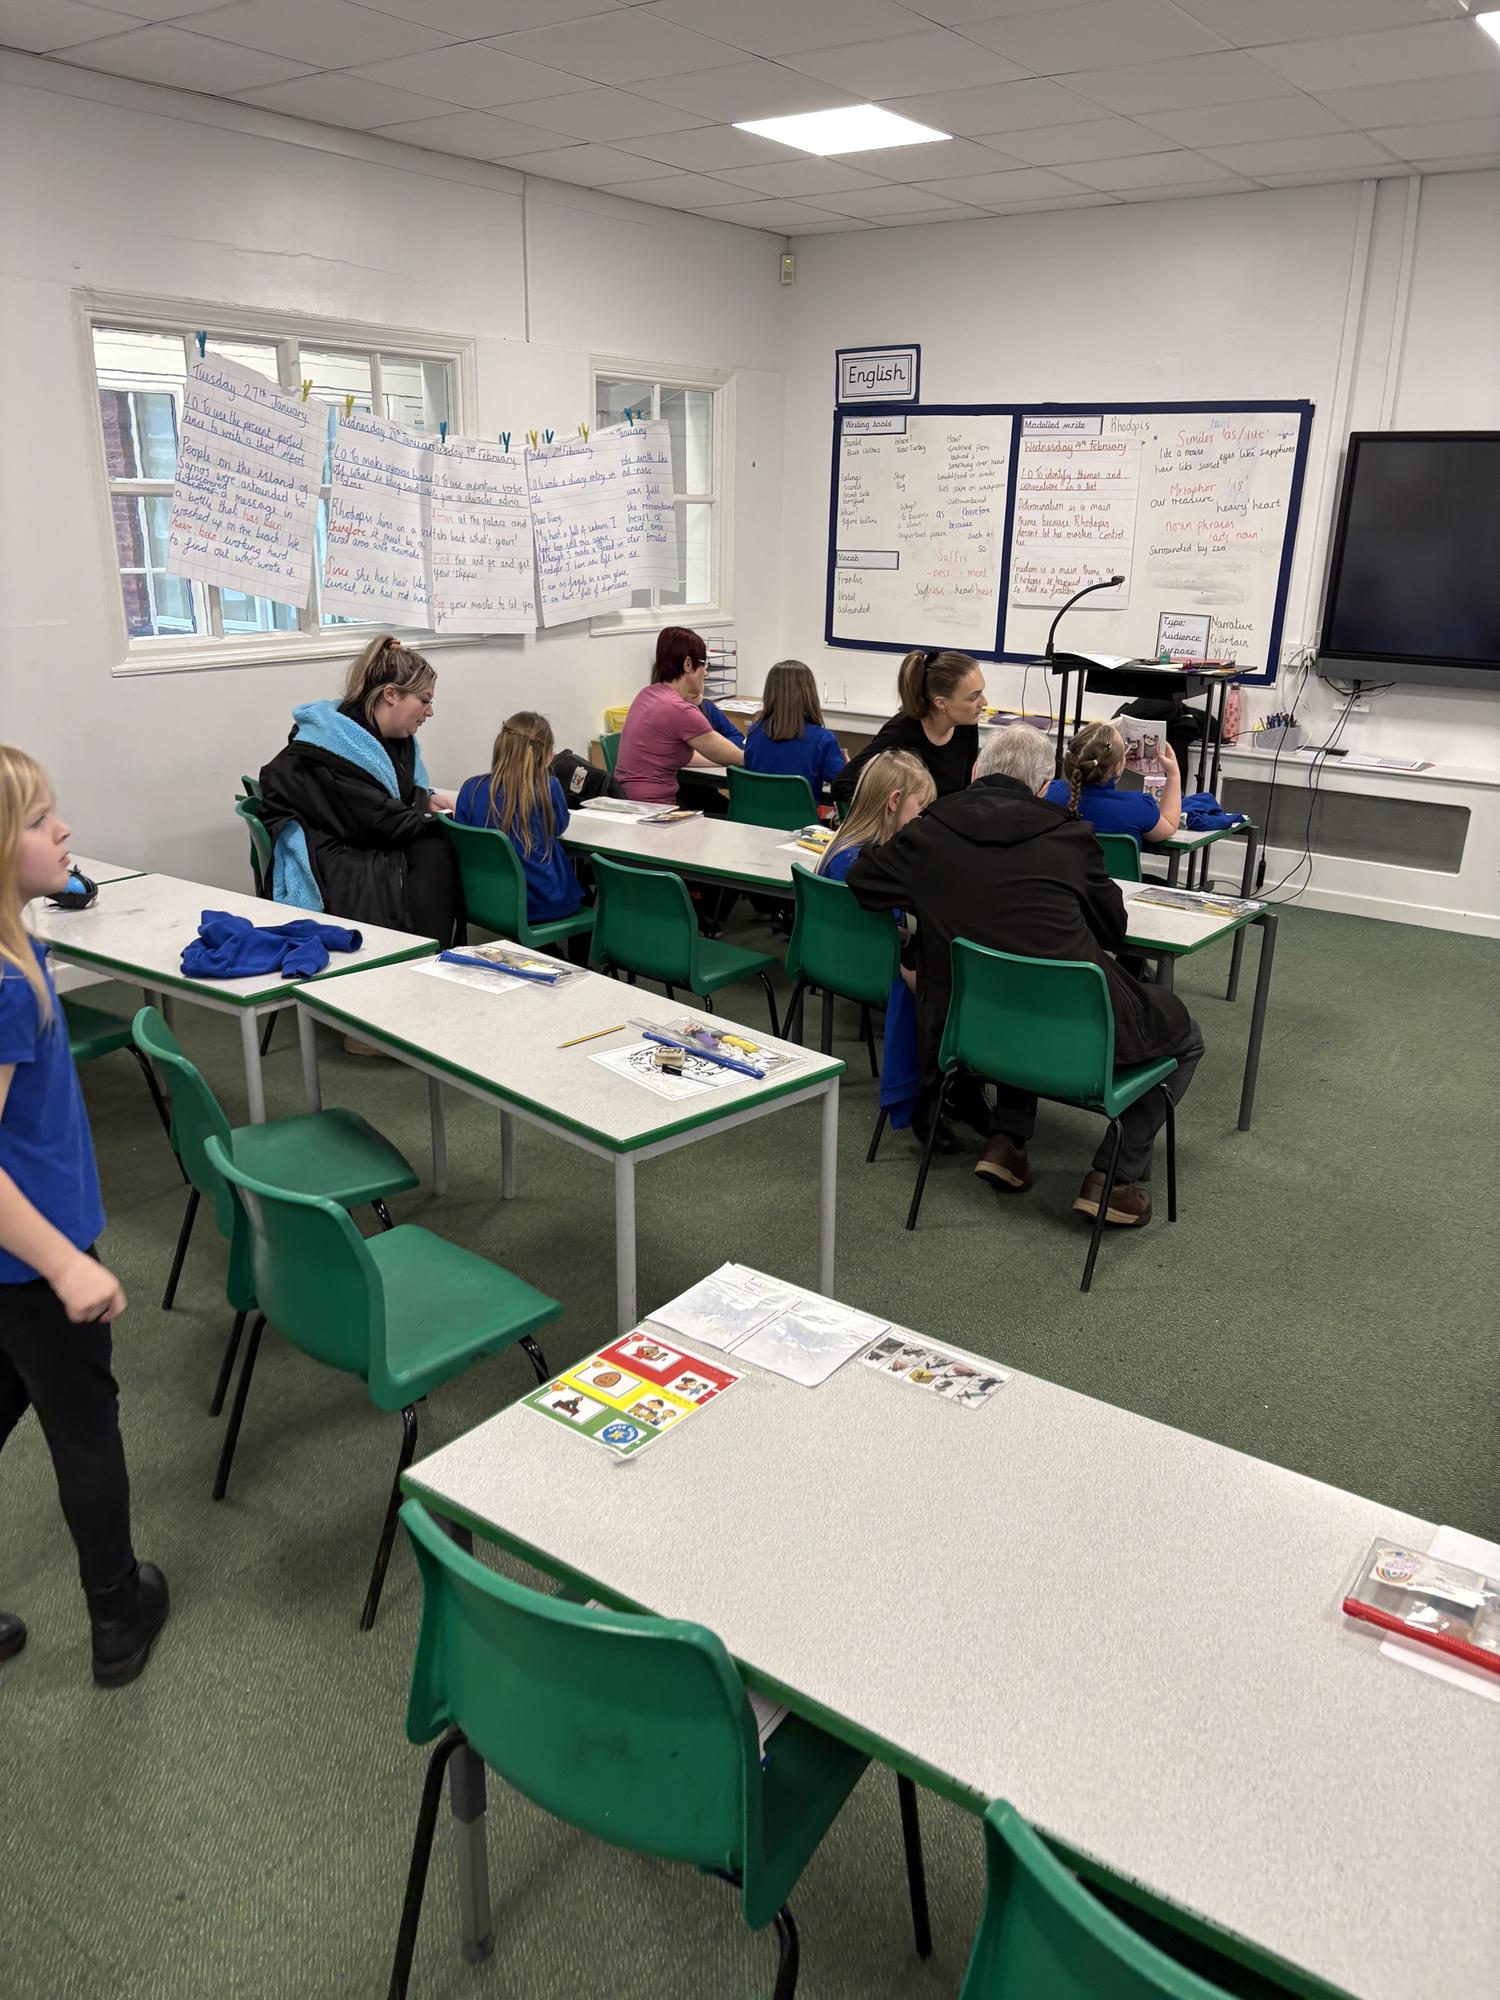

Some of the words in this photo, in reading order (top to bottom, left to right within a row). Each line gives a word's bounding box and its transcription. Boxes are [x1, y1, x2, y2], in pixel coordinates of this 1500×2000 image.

[849, 363, 905, 388] English
[193, 363, 236, 401] Tuesday
[244, 384, 266, 400] 27th
[270, 394, 308, 427] January
[213, 409, 226, 420] use
[230, 406, 240, 424] the
[276, 433, 304, 452] perfect
[846, 421, 869, 430] Writing
[1025, 421, 1059, 429] Modelled
[1063, 421, 1085, 429] write
[211, 421, 218, 434] to
[222, 429, 242, 443] write
[246, 437, 251, 445] a
[256, 438, 273, 454] short
[1176, 429, 1214, 448] Similes
[1024, 440, 1074, 458] Wednesday
[1090, 440, 1127, 456] February
[183, 436, 211, 464] People
[217, 457, 230, 470] on
[237, 460, 250, 475] the
[257, 469, 294, 489] island
[300, 484, 308, 498] of
[1107, 469, 1121, 479] and
[1178, 461, 1192, 471] like
[178, 456, 210, 479] Samos
[216, 472, 235, 485] were
[241, 480, 288, 503] astounded
[296, 493, 306, 508] to
[221, 490, 227, 498] a
[235, 493, 276, 519] message
[284, 509, 293, 520] in
[1091, 503, 1111, 511] main
[1171, 496, 1214, 505] treasure
[1252, 499, 1281, 511] heart
[175, 490, 182, 498] a
[189, 492, 212, 511] bottle
[218, 501, 237, 516] that
[243, 509, 258, 525] has
[264, 517, 282, 531] been
[331, 498, 373, 526] Rhodopis
[173, 505, 209, 522] washed
[212, 518, 222, 529] up
[227, 522, 236, 530] on
[239, 521, 251, 536] the
[256, 527, 280, 544] beach
[328, 519, 367, 538] therefore
[948, 520, 972, 529] because
[1042, 514, 1069, 527] because
[1197, 520, 1234, 534] phrases
[172, 516, 192, 533] have
[199, 525, 217, 541] been
[223, 537, 261, 560] working
[268, 545, 288, 560] hard
[170, 534, 179, 546] to
[183, 537, 208, 555] find
[215, 548, 229, 559] out
[235, 552, 253, 565] who
[257, 560, 281, 574] wrote
[286, 565, 295, 578] it
[1198, 542, 1208, 556] by
[326, 556, 349, 576] Since
[355, 568, 370, 582] she
[375, 568, 389, 585] has
[362, 585, 375, 595] she
[380, 585, 393, 598] has
[398, 590, 409, 600] red
[1163, 617, 1186, 629] Type:
[1211, 616, 1254, 631] Narrative
[1161, 631, 1202, 642] Audience:
[1160, 645, 1197, 656] Purpose:
